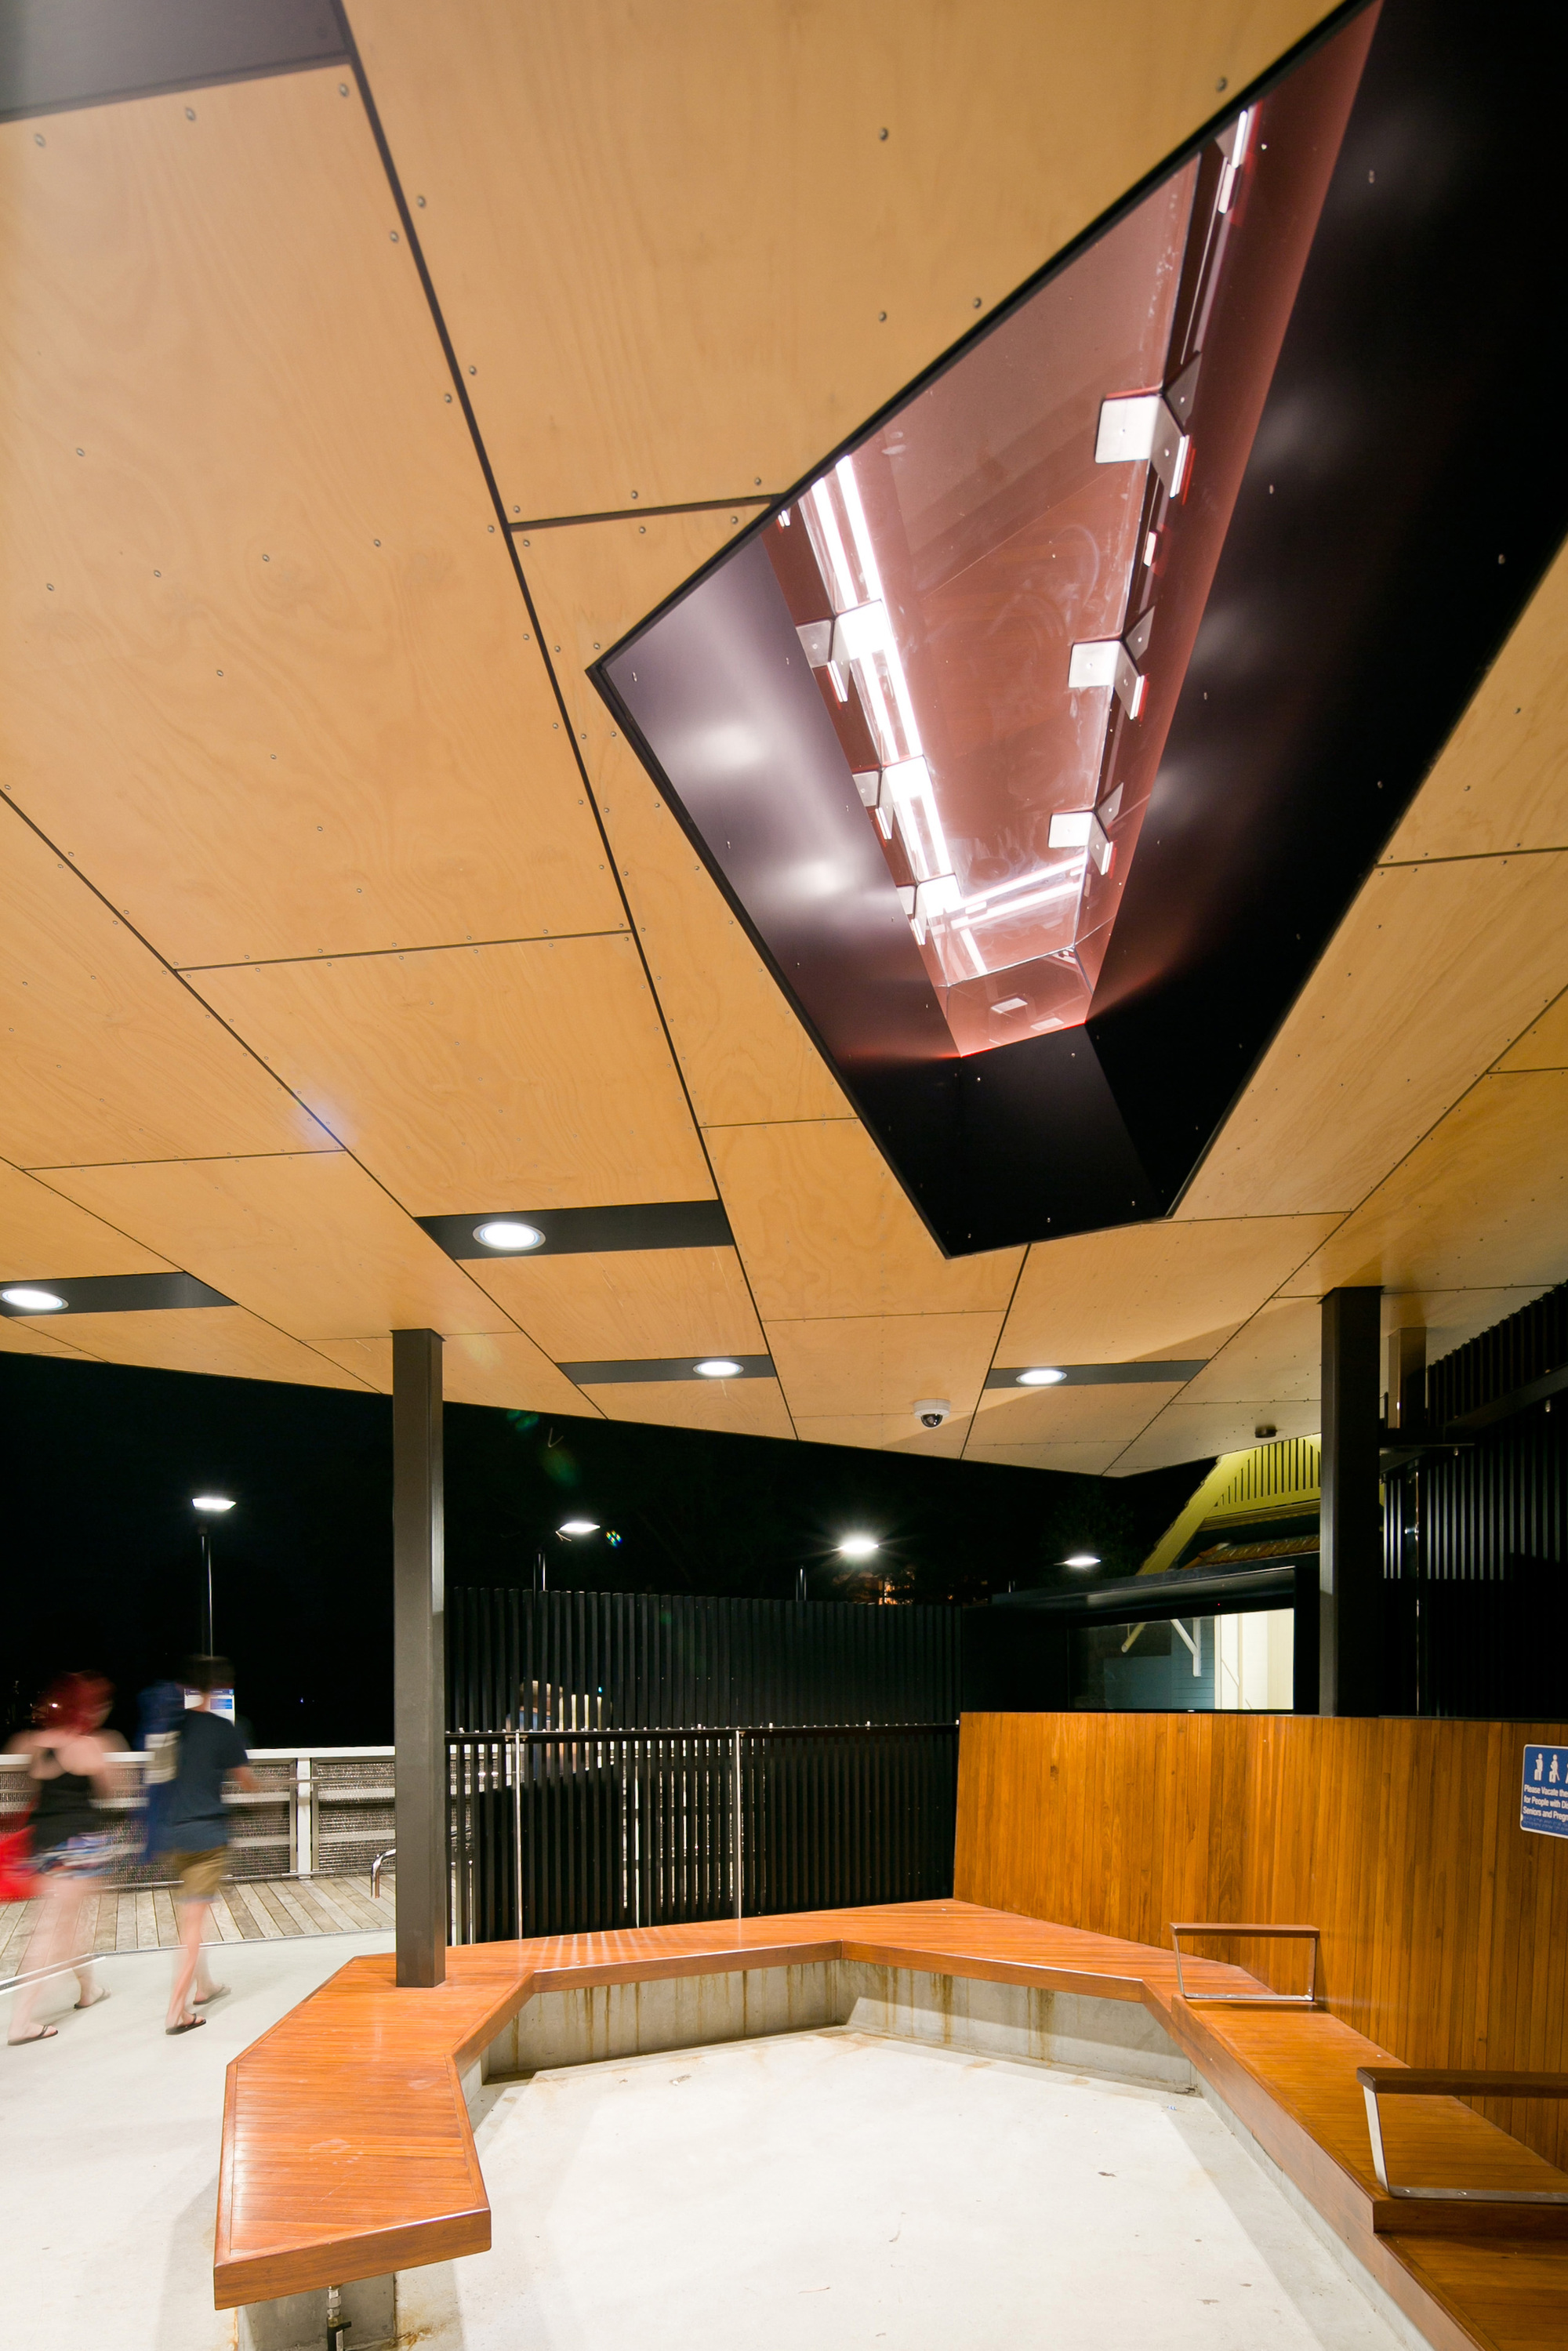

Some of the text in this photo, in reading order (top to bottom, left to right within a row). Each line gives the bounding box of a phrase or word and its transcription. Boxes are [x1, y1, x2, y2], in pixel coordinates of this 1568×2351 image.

[1524, 1784, 1541, 1794] Please
[1541, 1787, 1559, 1796] Vacate
[1532, 1796, 1549, 1807] People
[1550, 1799, 1561, 1808] with
[1523, 1806, 1541, 1816] Seniors
